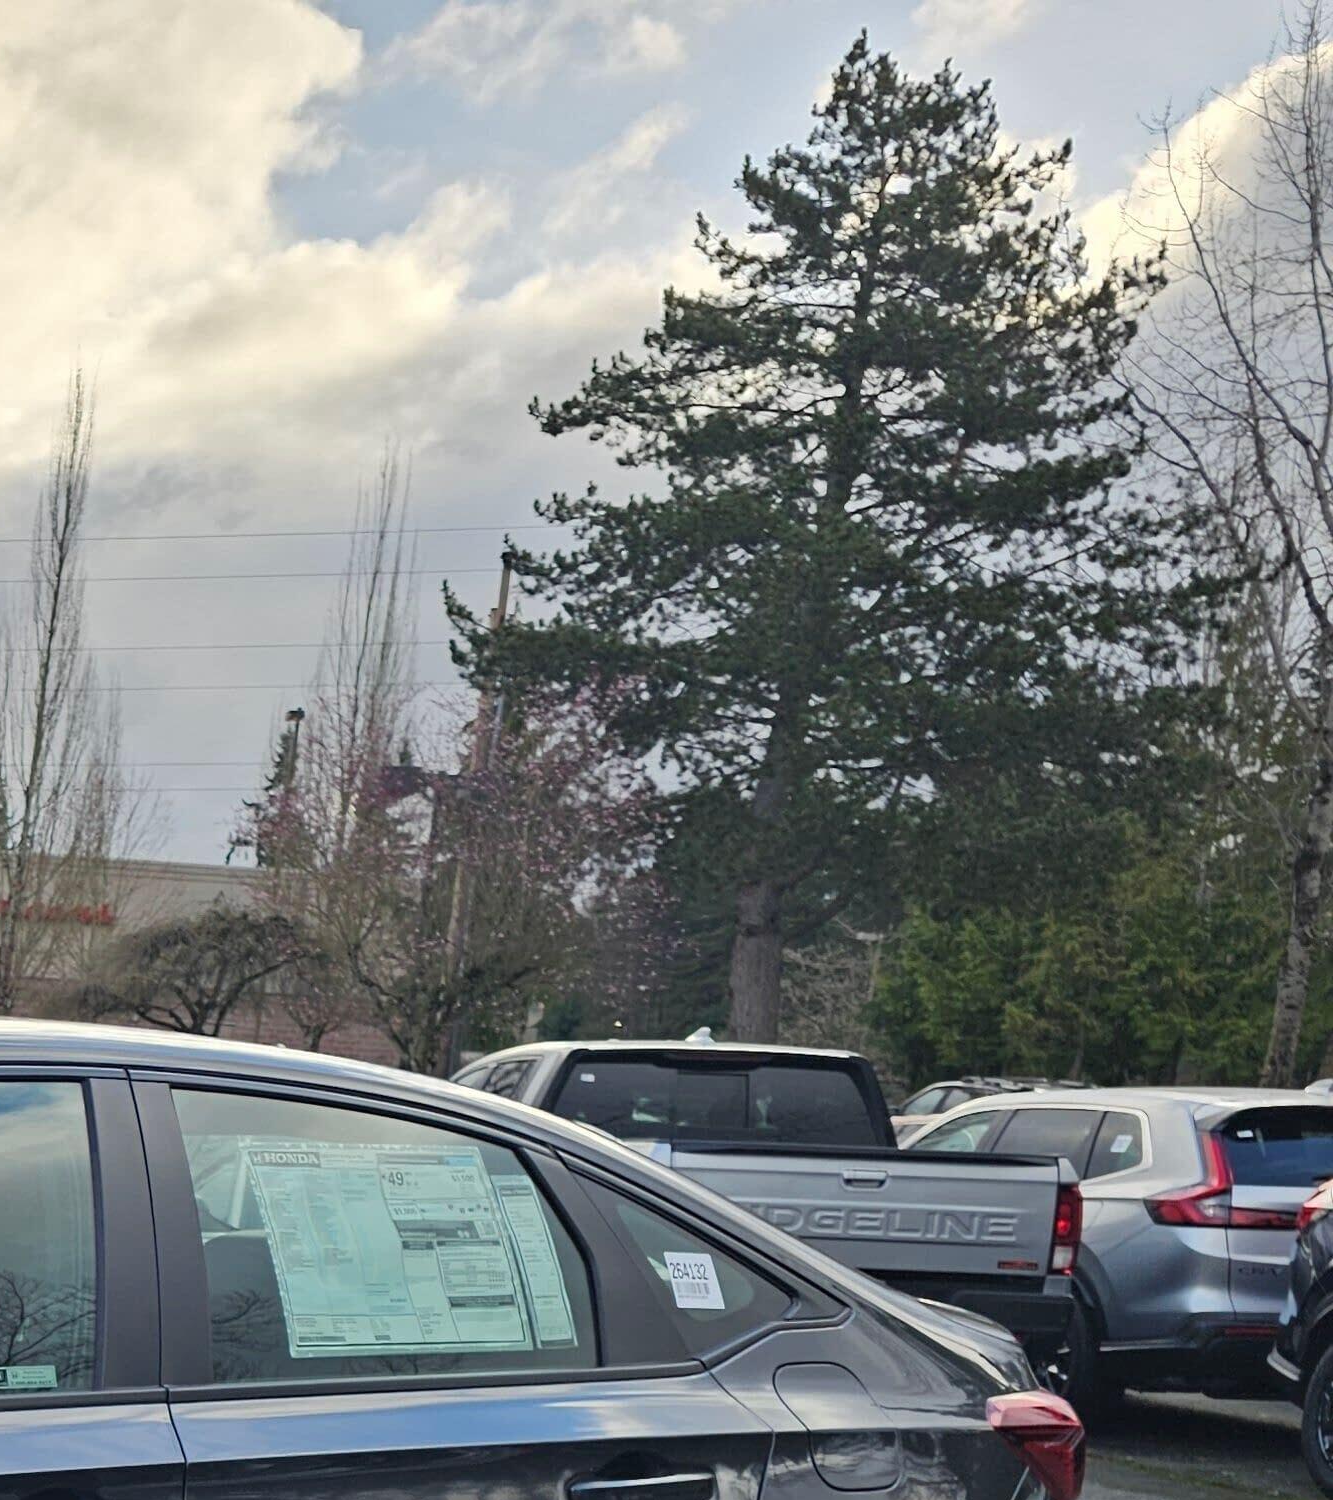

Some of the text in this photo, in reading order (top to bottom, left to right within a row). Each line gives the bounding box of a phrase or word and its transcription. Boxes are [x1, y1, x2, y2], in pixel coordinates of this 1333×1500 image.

[263, 1152, 319, 1165] HONDA
[388, 1171, 404, 1187] 49
[757, 1204, 1019, 1243] DGELINE
[669, 1261, 710, 1281] 264132
